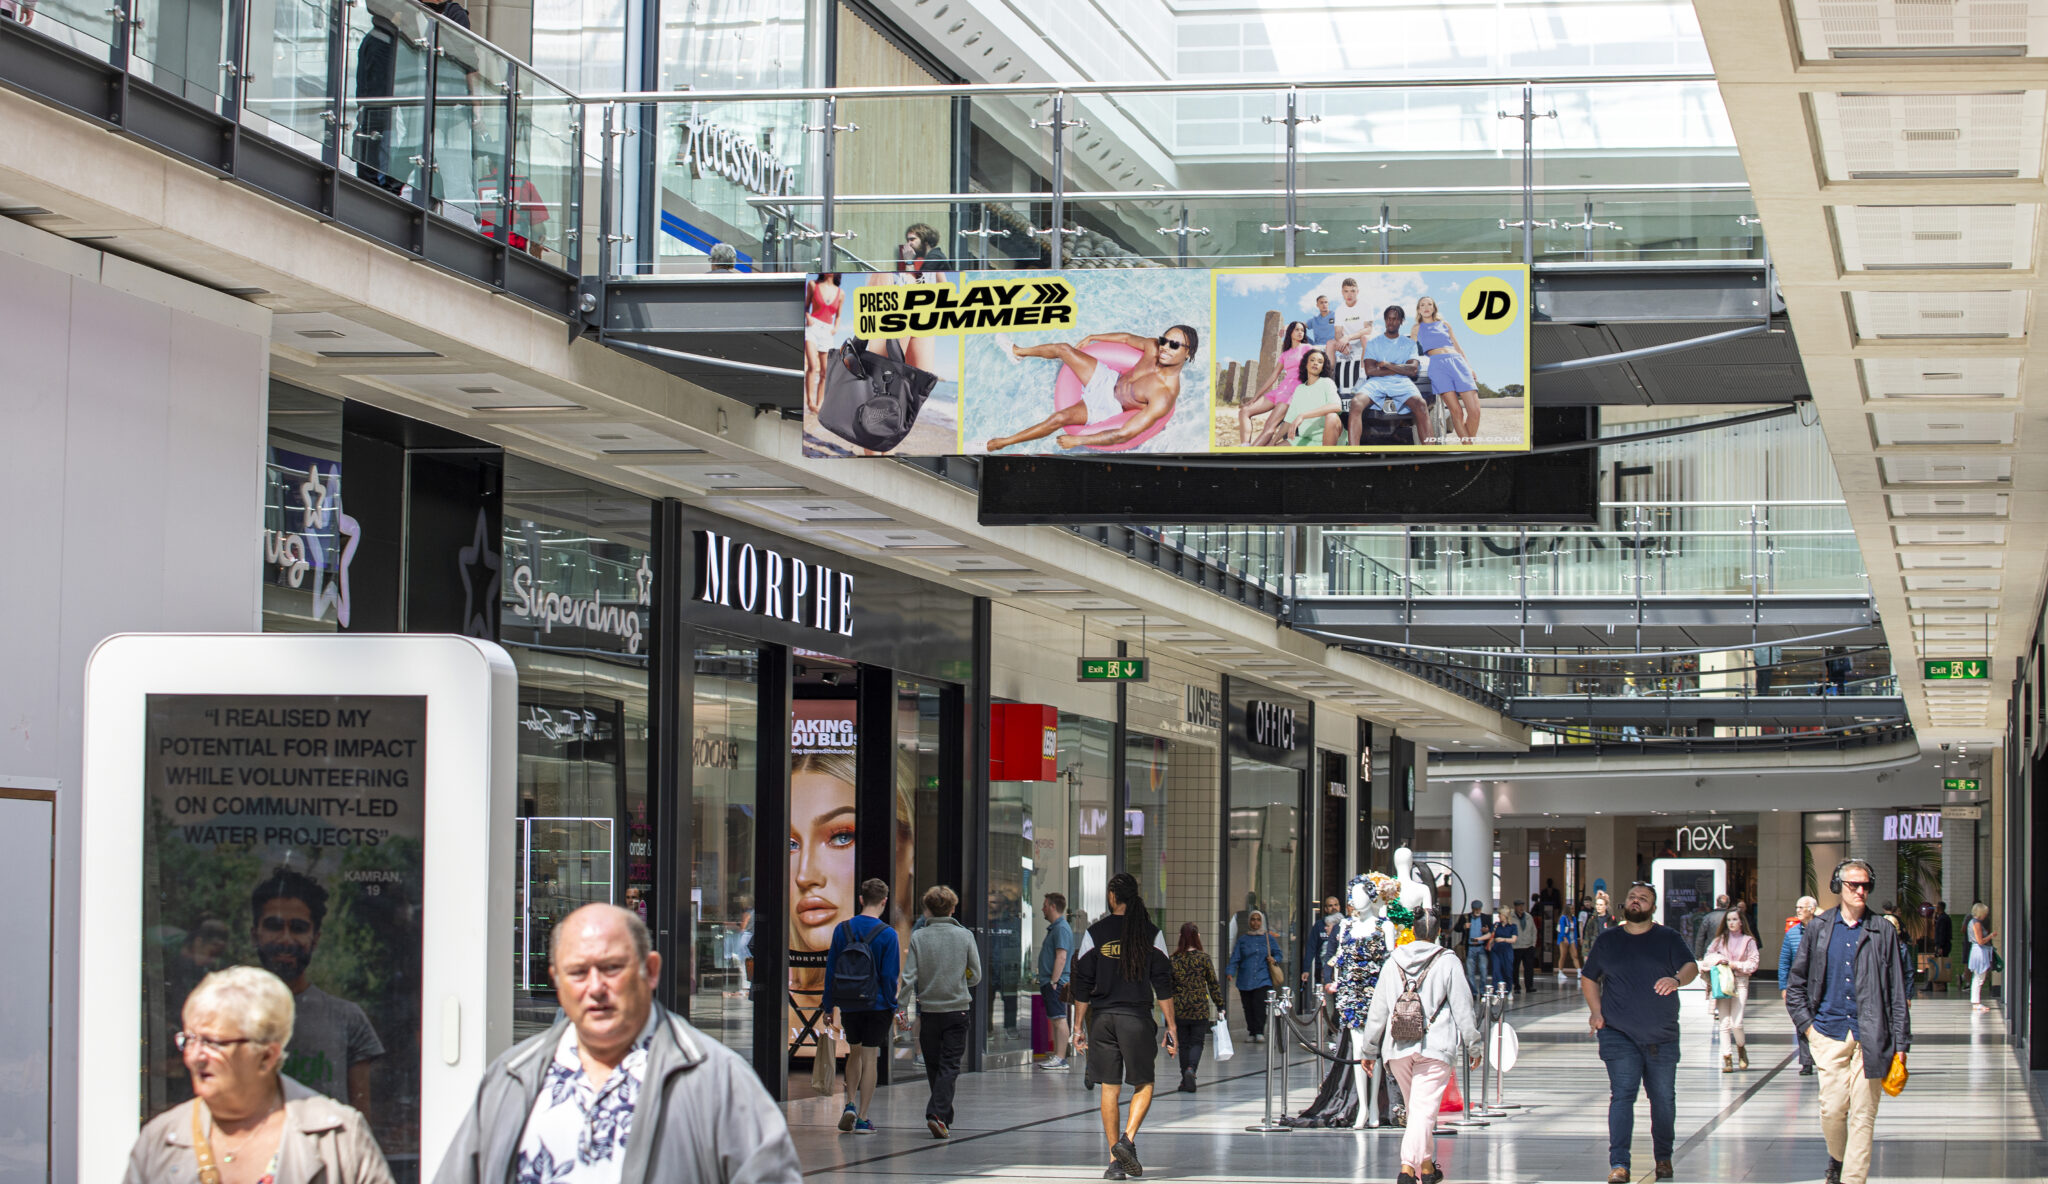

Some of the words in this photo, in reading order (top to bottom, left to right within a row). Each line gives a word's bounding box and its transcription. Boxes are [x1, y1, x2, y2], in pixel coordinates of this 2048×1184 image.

[684, 85, 795, 213] Accessorize
[860, 291, 898, 313] PRESS
[903, 284, 1024, 310] PLAY
[1467, 291, 1511, 320] JD
[860, 315, 876, 333] ON
[879, 304, 1072, 333] SUMMER
[702, 530, 854, 637] MORPHE
[513, 565, 642, 654] Superdrug
[1088, 665, 1104, 674] Exit
[1930, 666, 1947, 675] Exit
[1187, 684, 1211, 727] LUSH
[205, 709, 219, 727] “I
[226, 709, 330, 727] REALISED
[337, 710, 371, 728] MY
[792, 719, 853, 733] AKING
[1256, 700, 1295, 751] OFFICE
[160, 738, 277, 757] POTENTIAL
[284, 739, 327, 757] FOR
[334, 740, 417, 758] IMPACT
[792, 733, 815, 746] OU
[166, 767, 233, 785] WHILE
[239, 767, 409, 788] VOLUNTEERING
[175, 797, 206, 815] ON
[213, 797, 398, 817] COMMUNITY-LED
[184, 826, 256, 844] WATER
[264, 827, 389, 847] PROJECTS”
[1677, 824, 1734, 851] next
[344, 871, 403, 884] KAMRAN,
[366, 885, 380, 896] 19
[788, 954, 828, 962] MORPHE
